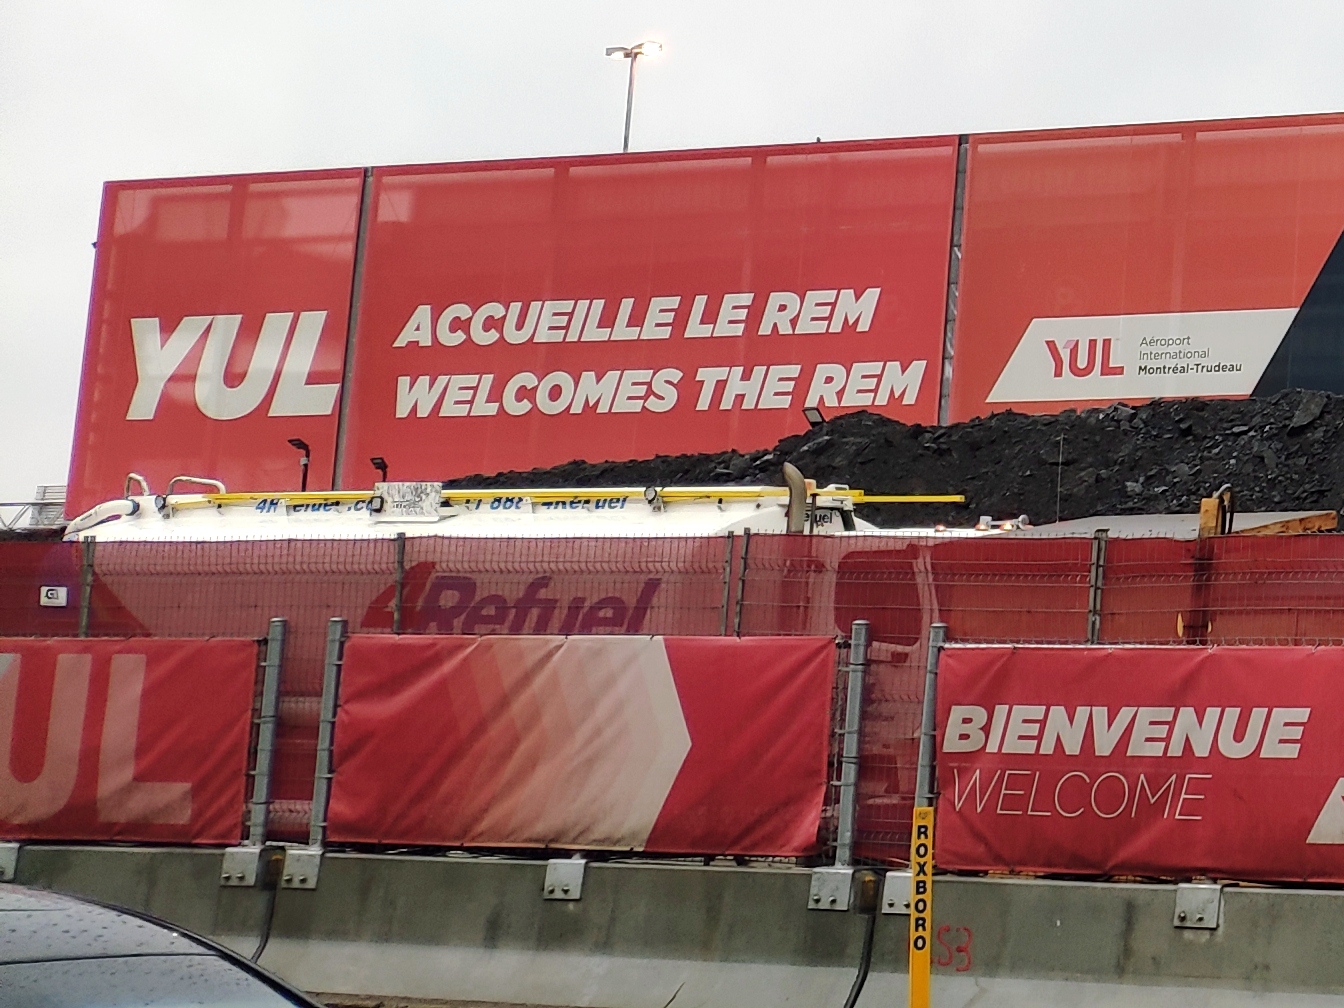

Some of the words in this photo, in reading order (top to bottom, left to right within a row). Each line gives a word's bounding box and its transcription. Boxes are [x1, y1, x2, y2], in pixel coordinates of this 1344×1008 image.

[392, 296, 682, 348] ACCUEILLE
[684, 293, 755, 338] LE
[757, 287, 882, 336] REM
[1139, 335, 1191, 351] Aéroport
[126, 310, 341, 421] YUL
[1044, 337, 1125, 379] YUL
[1137, 361, 1243, 376] Montréal-Trudeau
[1139, 348, 1211, 361] International
[394, 367, 684, 419] WELCOMES
[695, 364, 802, 411] THE
[803, 360, 928, 409] REM
[361, 561, 662, 633] 4Refuel
[0, 653, 193, 826] UL
[942, 704, 1312, 759] BIENVENUE
[953, 767, 1213, 820] WELCOME
[914, 824, 929, 951] ROXBORO
